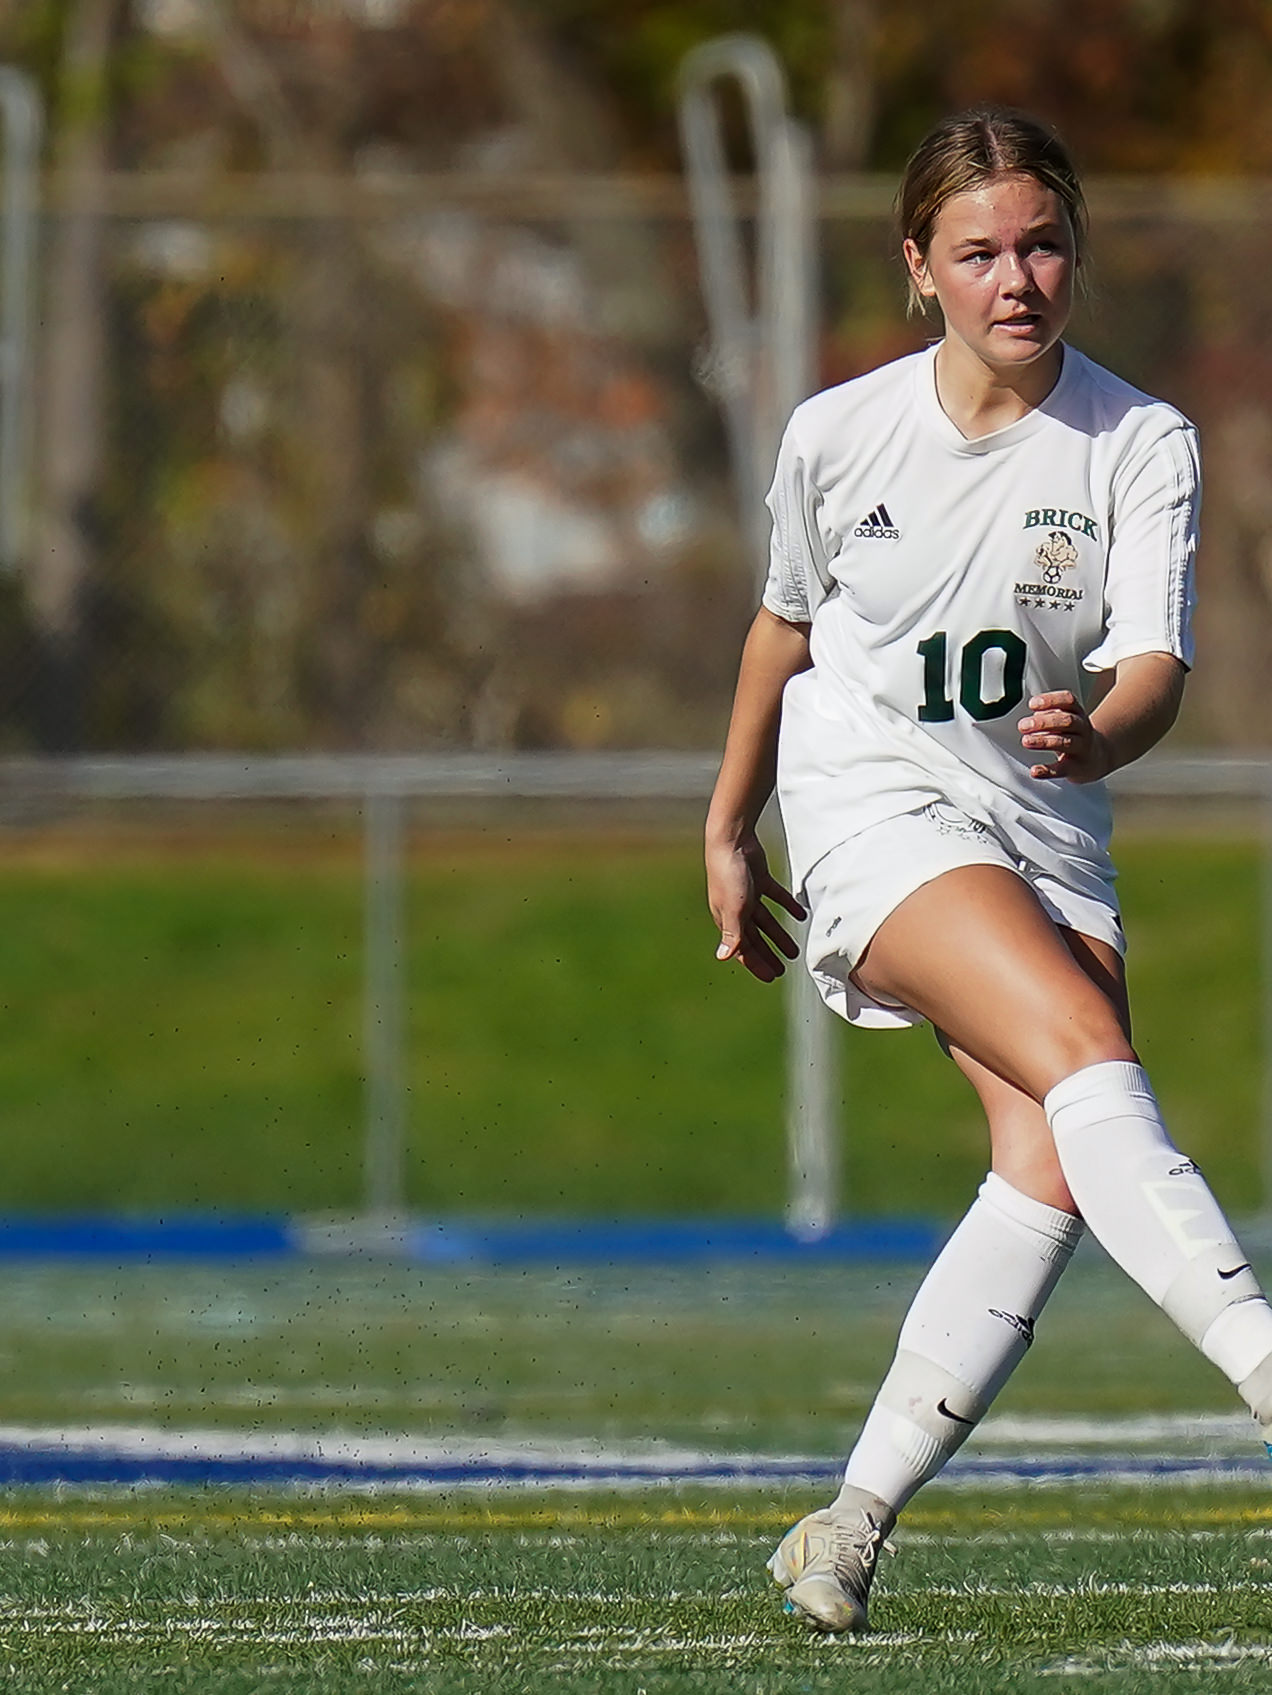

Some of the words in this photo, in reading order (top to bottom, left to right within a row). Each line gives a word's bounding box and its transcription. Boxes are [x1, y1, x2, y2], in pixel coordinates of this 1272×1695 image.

[854, 525, 900, 540] adidas
[1022, 508, 1098, 542] BRICK
[916, 628, 1028, 723] 10
